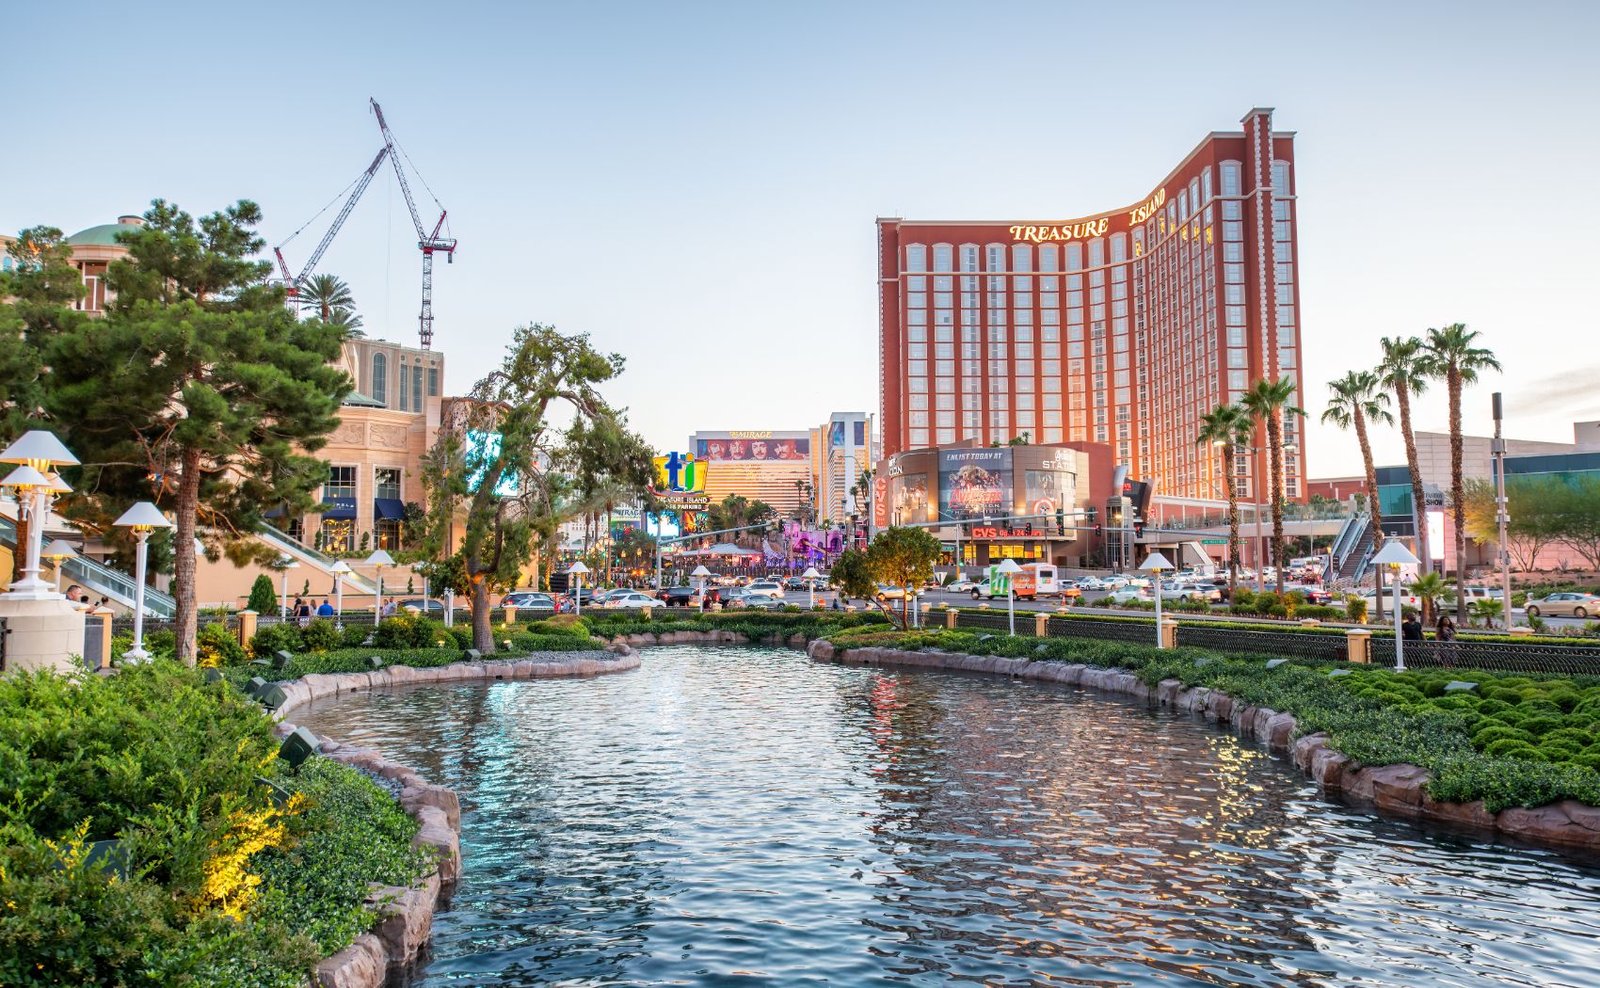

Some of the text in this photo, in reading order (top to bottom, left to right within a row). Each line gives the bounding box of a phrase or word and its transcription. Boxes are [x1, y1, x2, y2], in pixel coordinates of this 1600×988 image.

[1009, 188, 1166, 243] TREASURE ISLAND
[739, 431, 773, 439] MIRAGE
[686, 496, 708, 504] ISLAND
[875, 477, 887, 517] CVS
[972, 528, 997, 538] CVS
